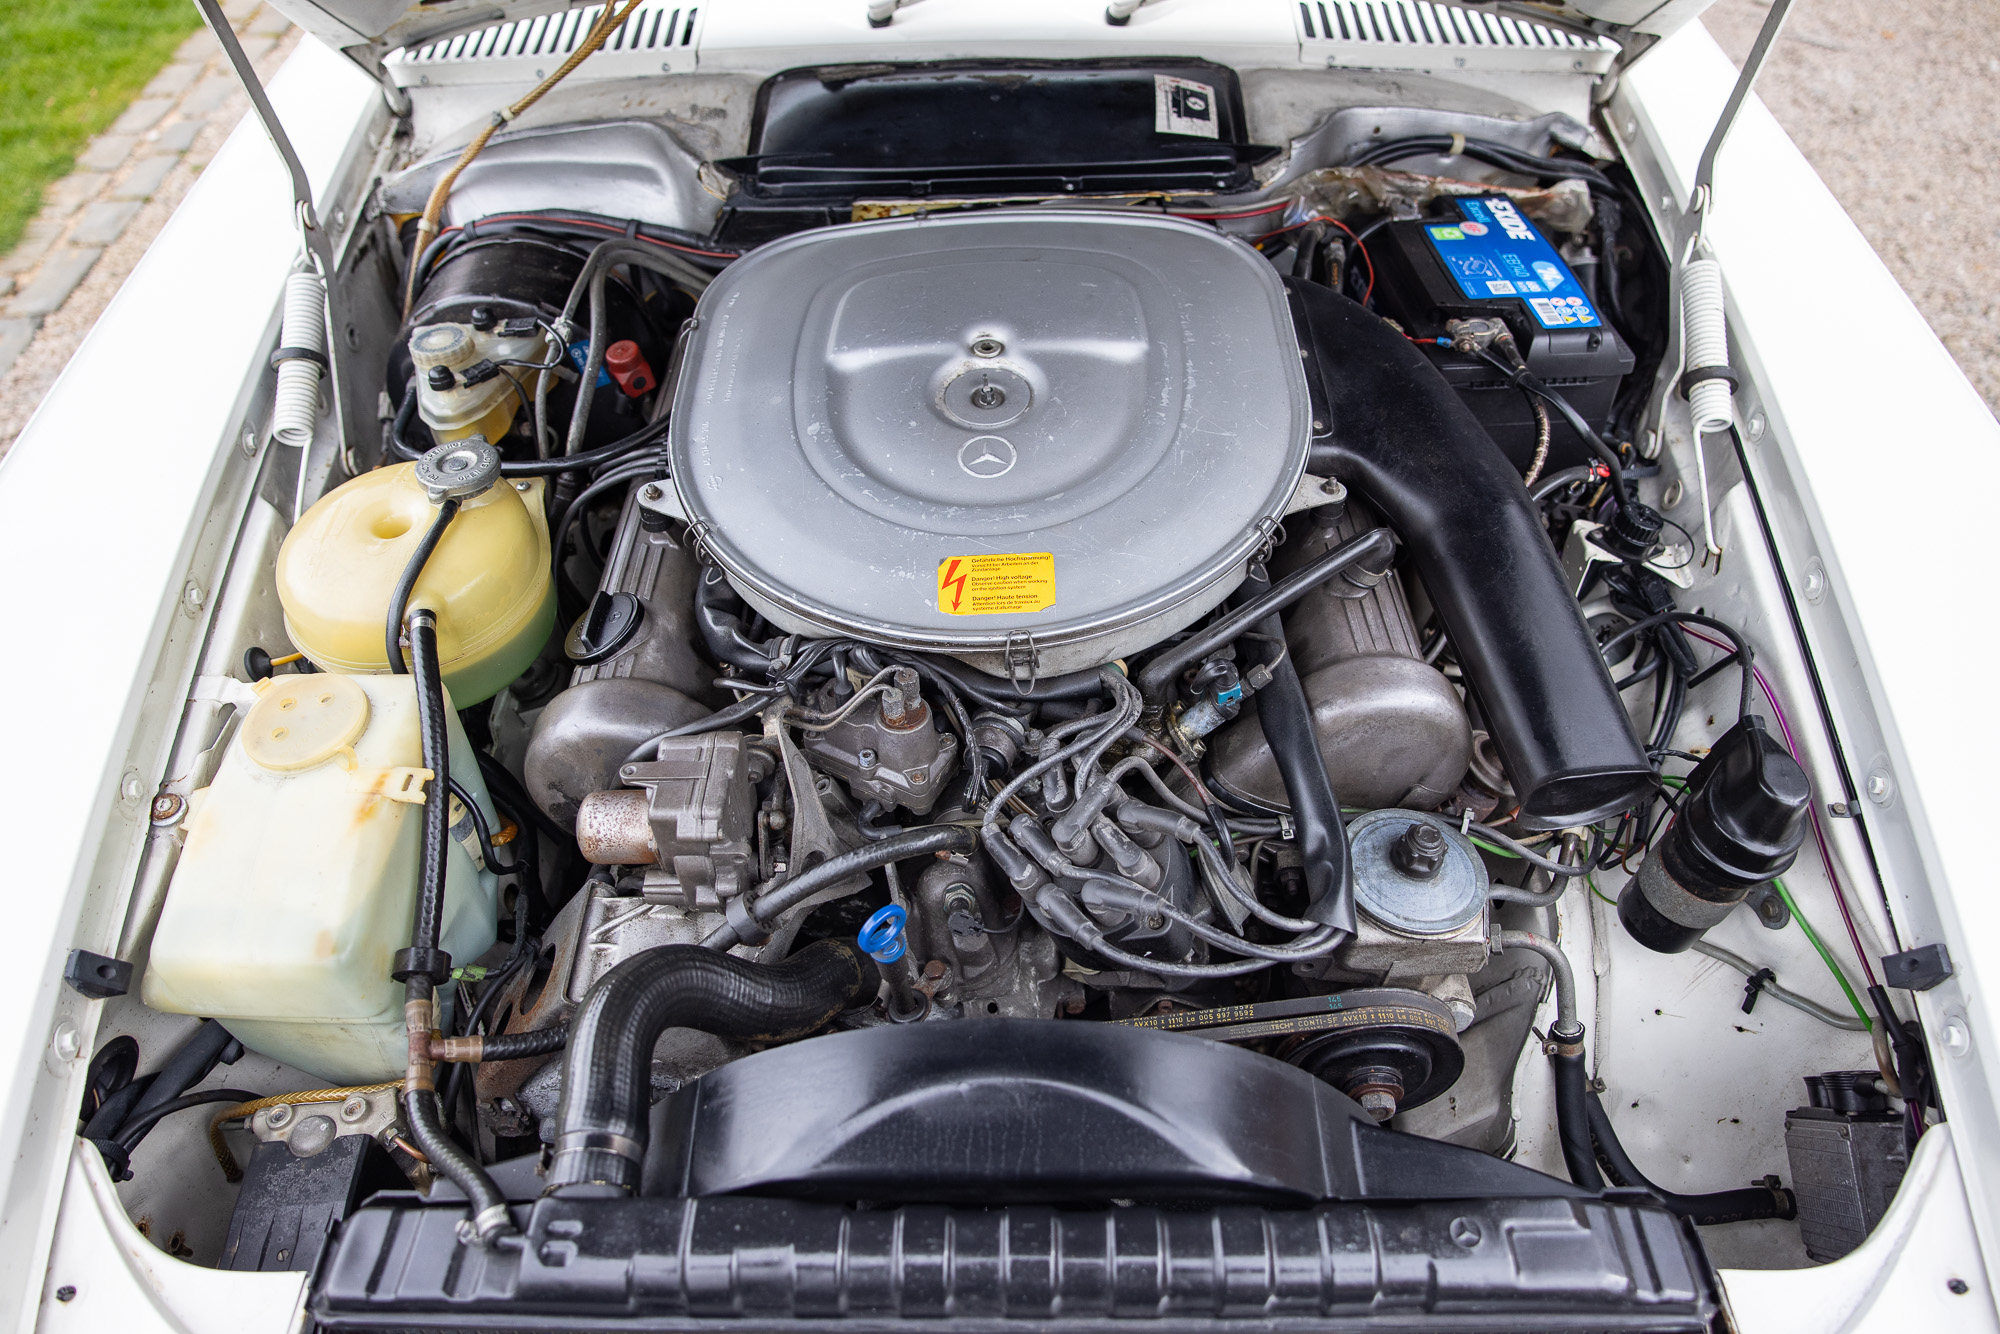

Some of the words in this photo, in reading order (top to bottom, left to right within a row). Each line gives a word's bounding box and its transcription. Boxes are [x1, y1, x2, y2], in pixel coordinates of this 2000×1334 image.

[1484, 199, 1536, 242] EXIDE
[457, 469, 482, 481] OPEN
[1168, 1017, 1183, 1025] 1110
[1186, 1015, 1196, 1023] La
[1199, 1012, 1214, 1021] 005
[1216, 1011, 1231, 1020] 997
[1233, 1009, 1254, 1018] 9592
[1297, 1016, 1338, 1027] CONTI-SF
[1342, 1013, 1368, 1022] AVX10
[1378, 1011, 1394, 1020] 1110
[1397, 1012, 1407, 1020] La
